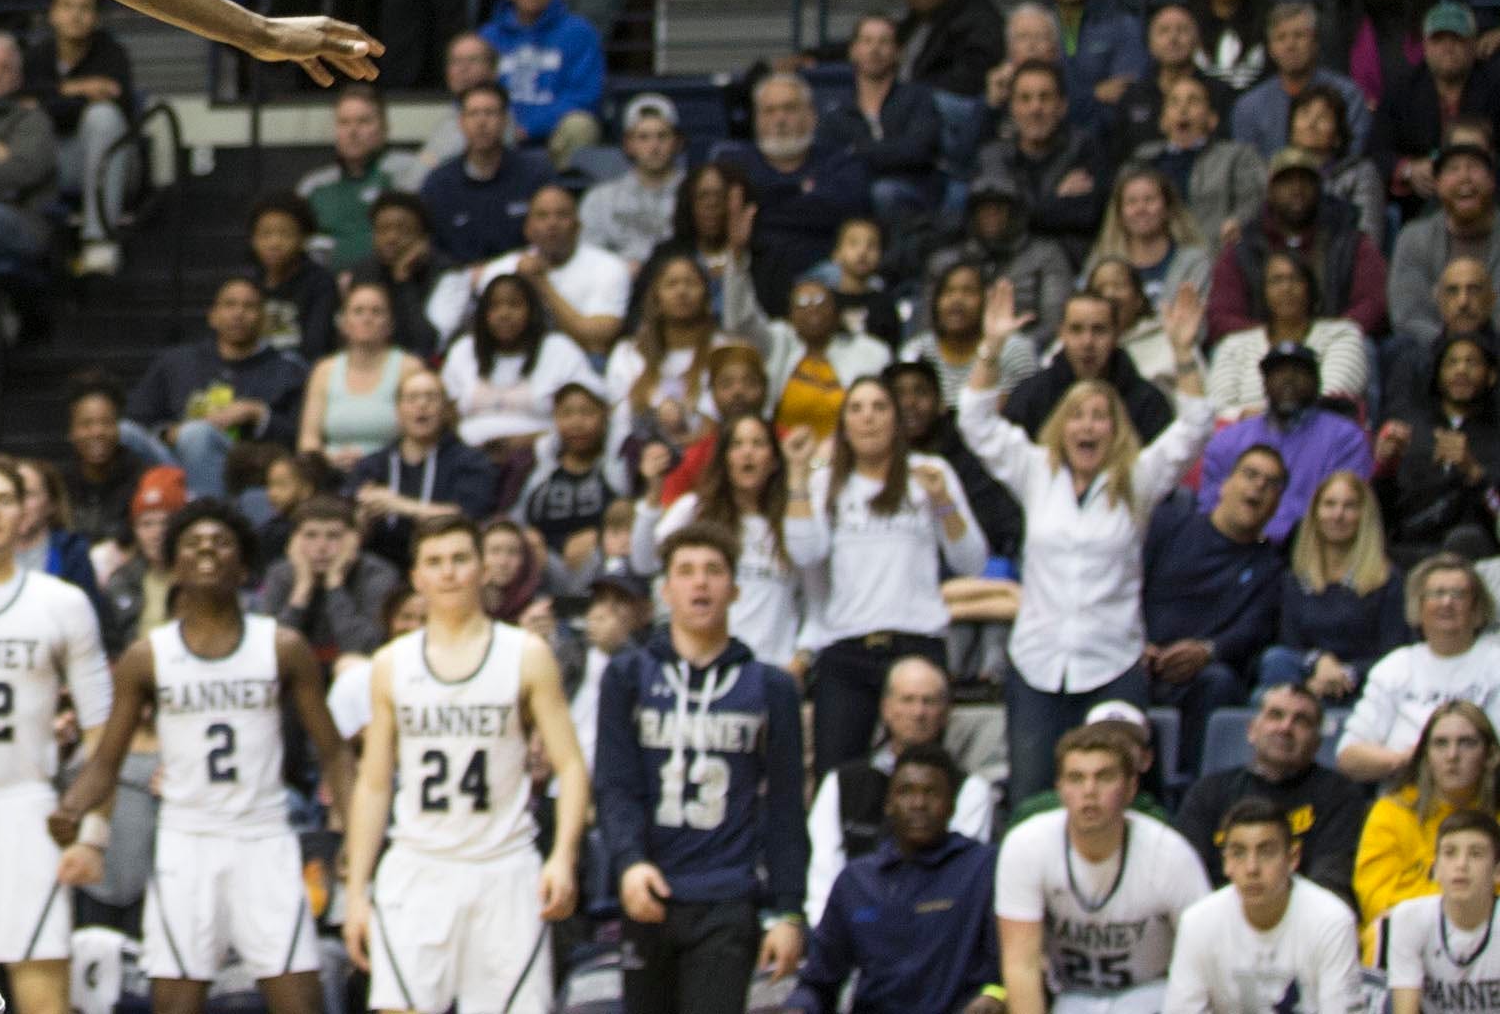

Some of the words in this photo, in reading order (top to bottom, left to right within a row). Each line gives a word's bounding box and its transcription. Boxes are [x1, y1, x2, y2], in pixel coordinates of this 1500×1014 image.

[400, 704, 514, 738] RANNEY
[206, 723, 238, 782] 2
[421, 749, 491, 813] 24
[655, 756, 731, 830] 13
[1058, 947, 1132, 989] 25
